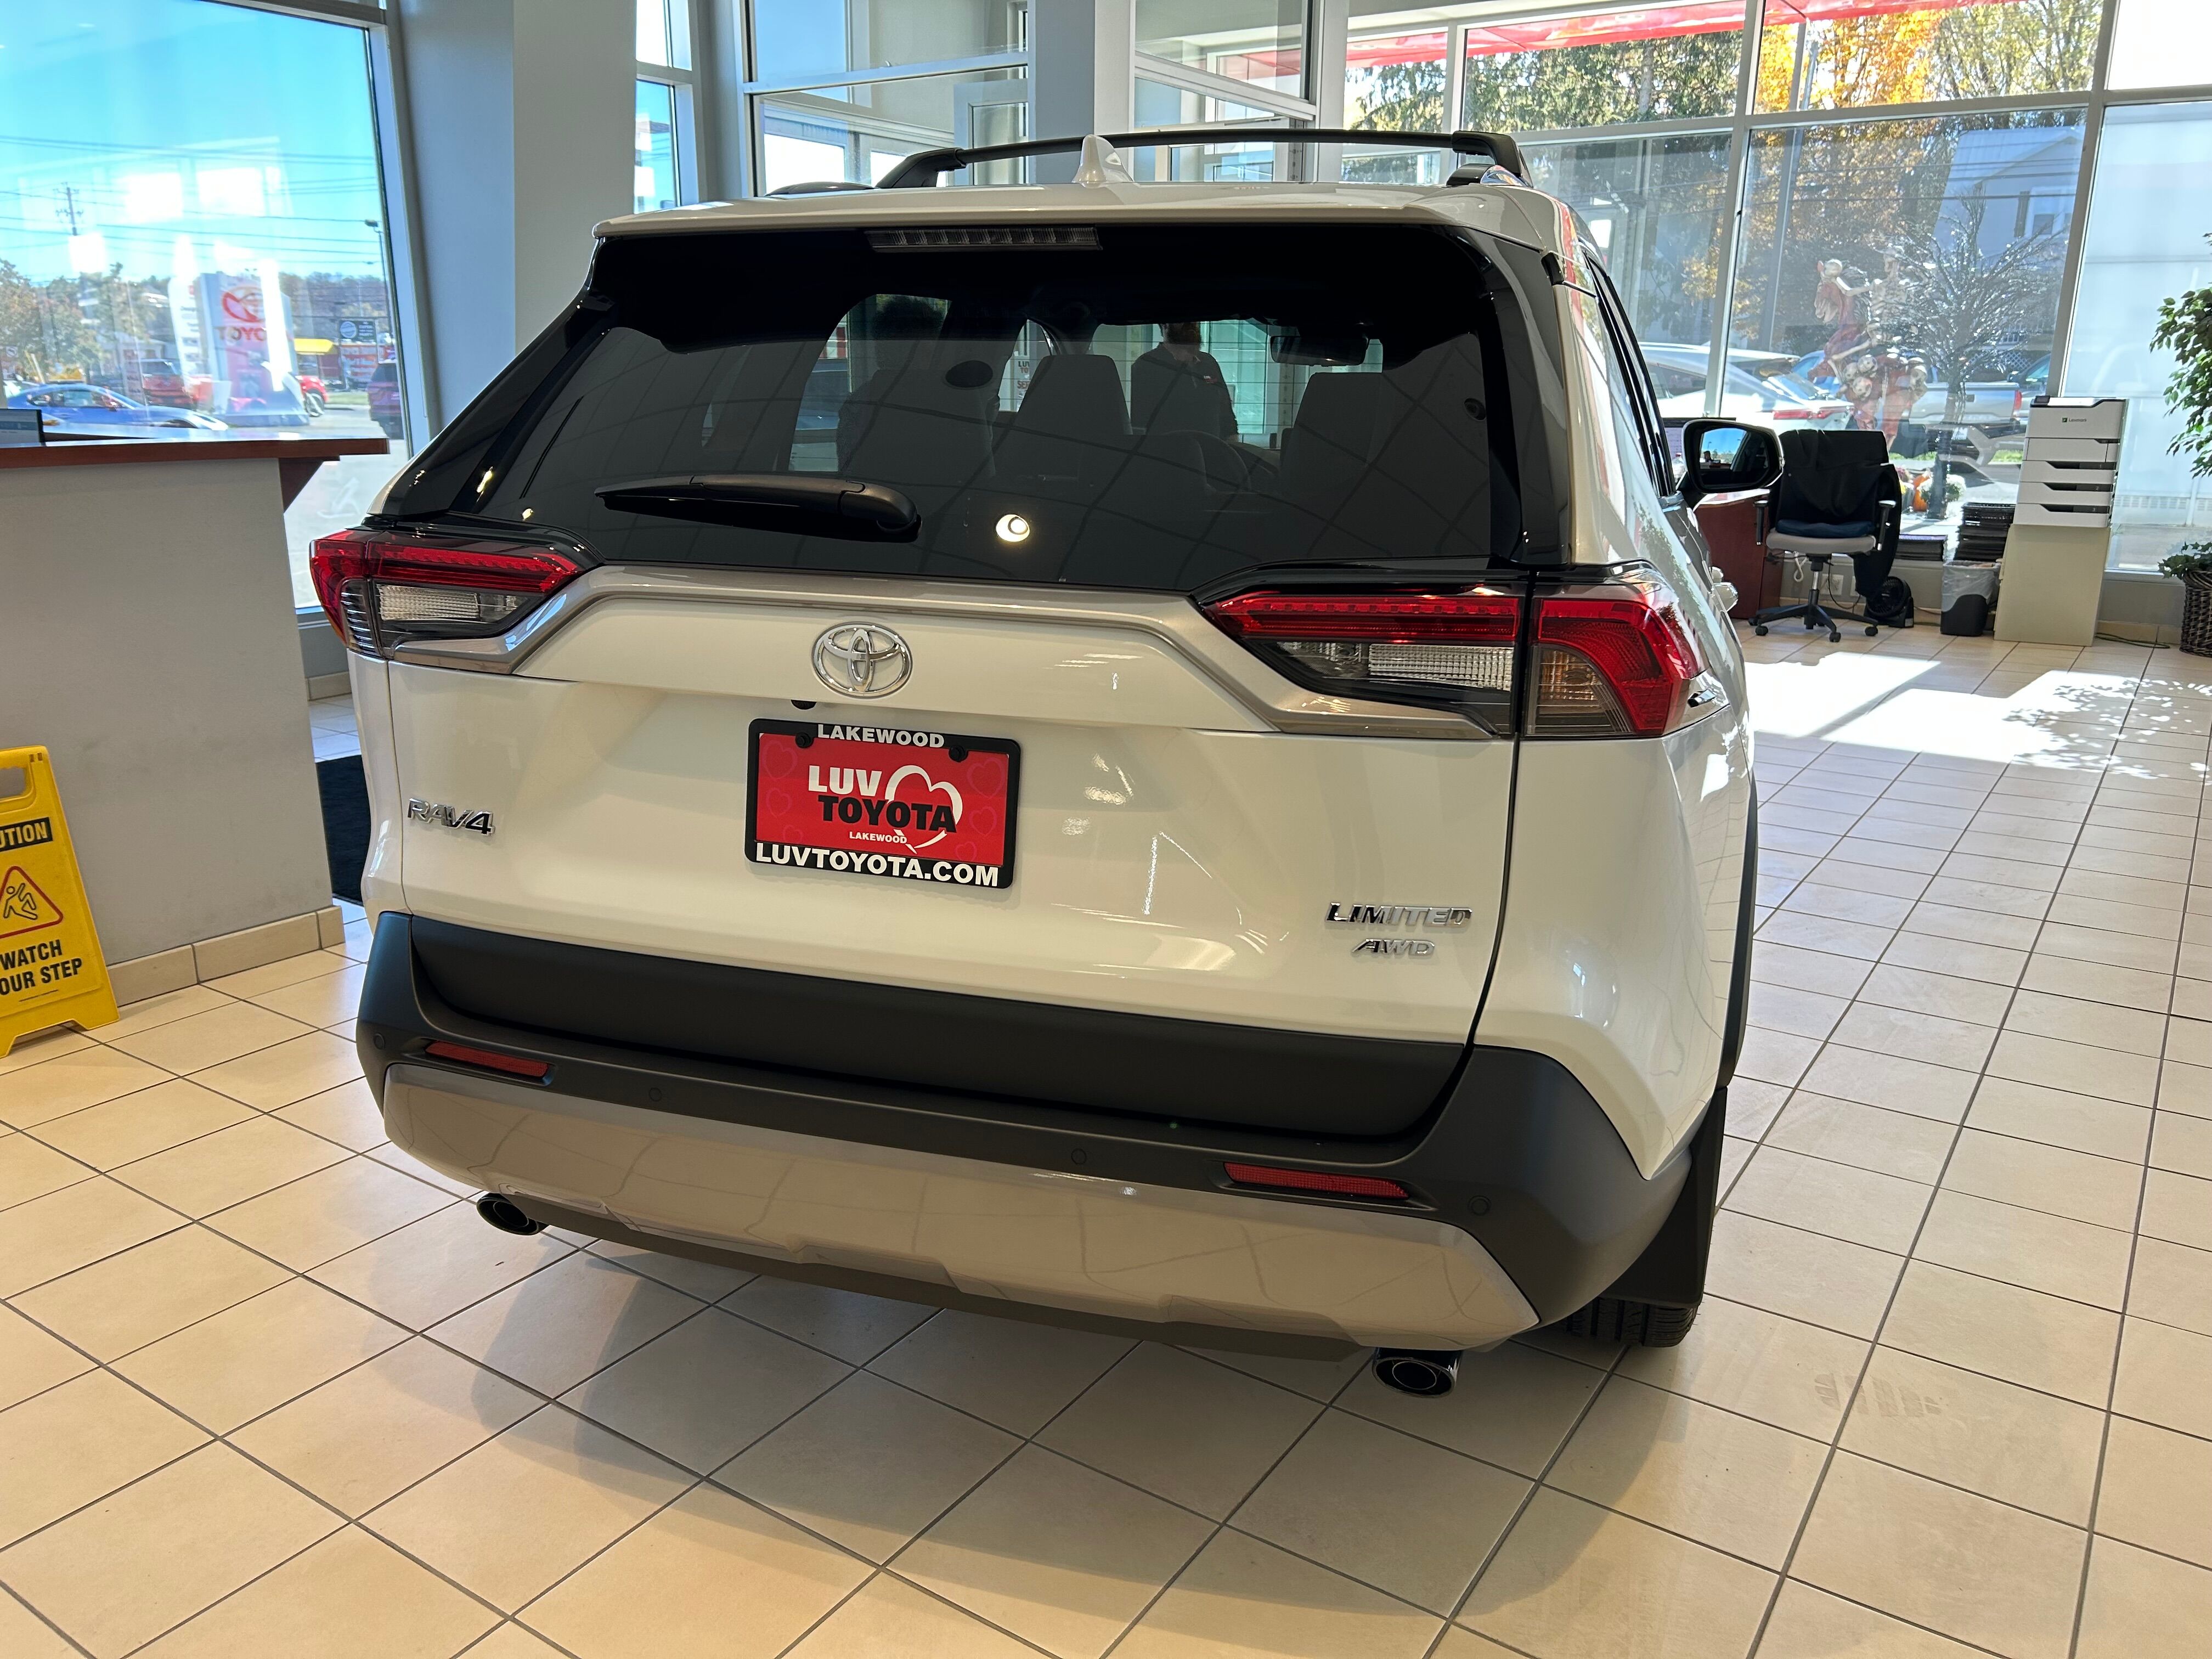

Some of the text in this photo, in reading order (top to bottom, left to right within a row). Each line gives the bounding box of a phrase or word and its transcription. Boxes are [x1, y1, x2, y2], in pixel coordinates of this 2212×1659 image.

[817, 724, 945, 748] LAKEWOOD
[808, 765, 882, 797] LUV
[407, 798, 496, 836] RAV4
[817, 794, 956, 833] TOYOTA
[849, 831, 907, 844] LAKEWOOD
[756, 843, 999, 887] LUVTOYOTA.COM
[1325, 902, 1473, 927] LIMITED
[1, 939, 63, 970] WATCH
[1351, 938, 1435, 956] AWD
[40, 957, 82, 984] STEP
